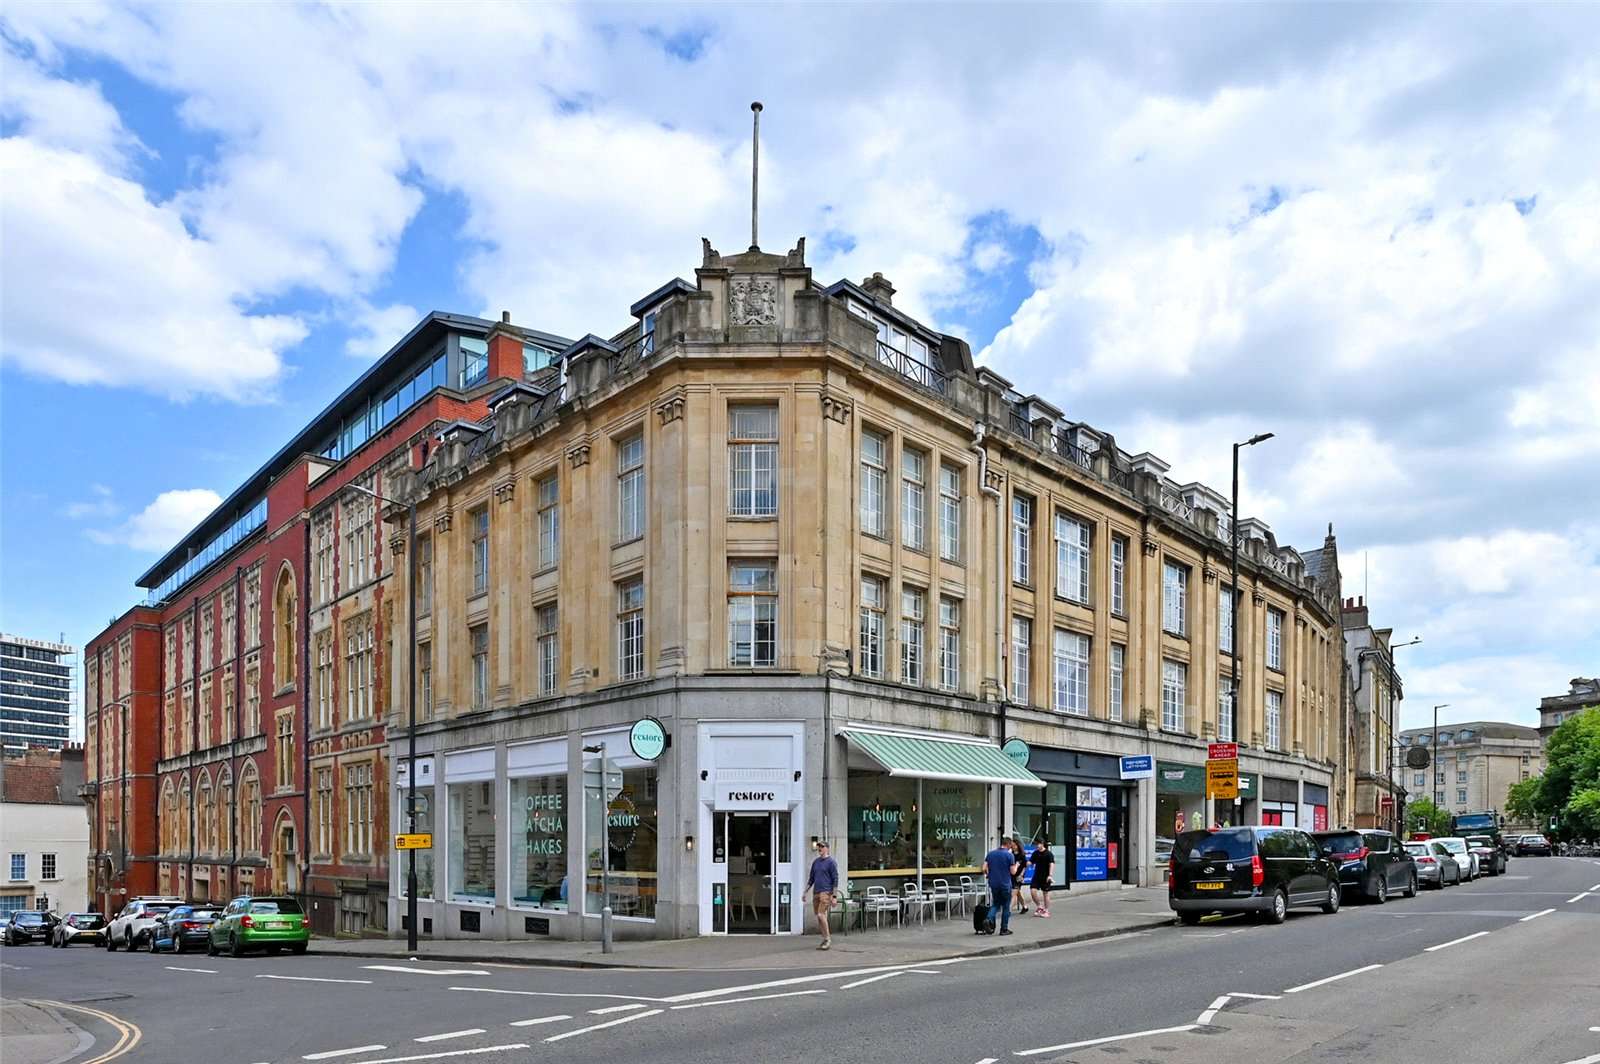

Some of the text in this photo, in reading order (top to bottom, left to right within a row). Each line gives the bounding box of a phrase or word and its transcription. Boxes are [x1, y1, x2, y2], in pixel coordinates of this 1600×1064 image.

[633, 733, 662, 742] restore
[526, 794, 562, 810] OFFEE
[728, 791, 775, 801] restore
[608, 814, 640, 827] estore
[862, 809, 905, 823] restore
[934, 812, 973, 824] MATCHA
[526, 816, 563, 832] ATCHA
[936, 828, 972, 841] SHAKES
[525, 839, 562, 855] HAKES
